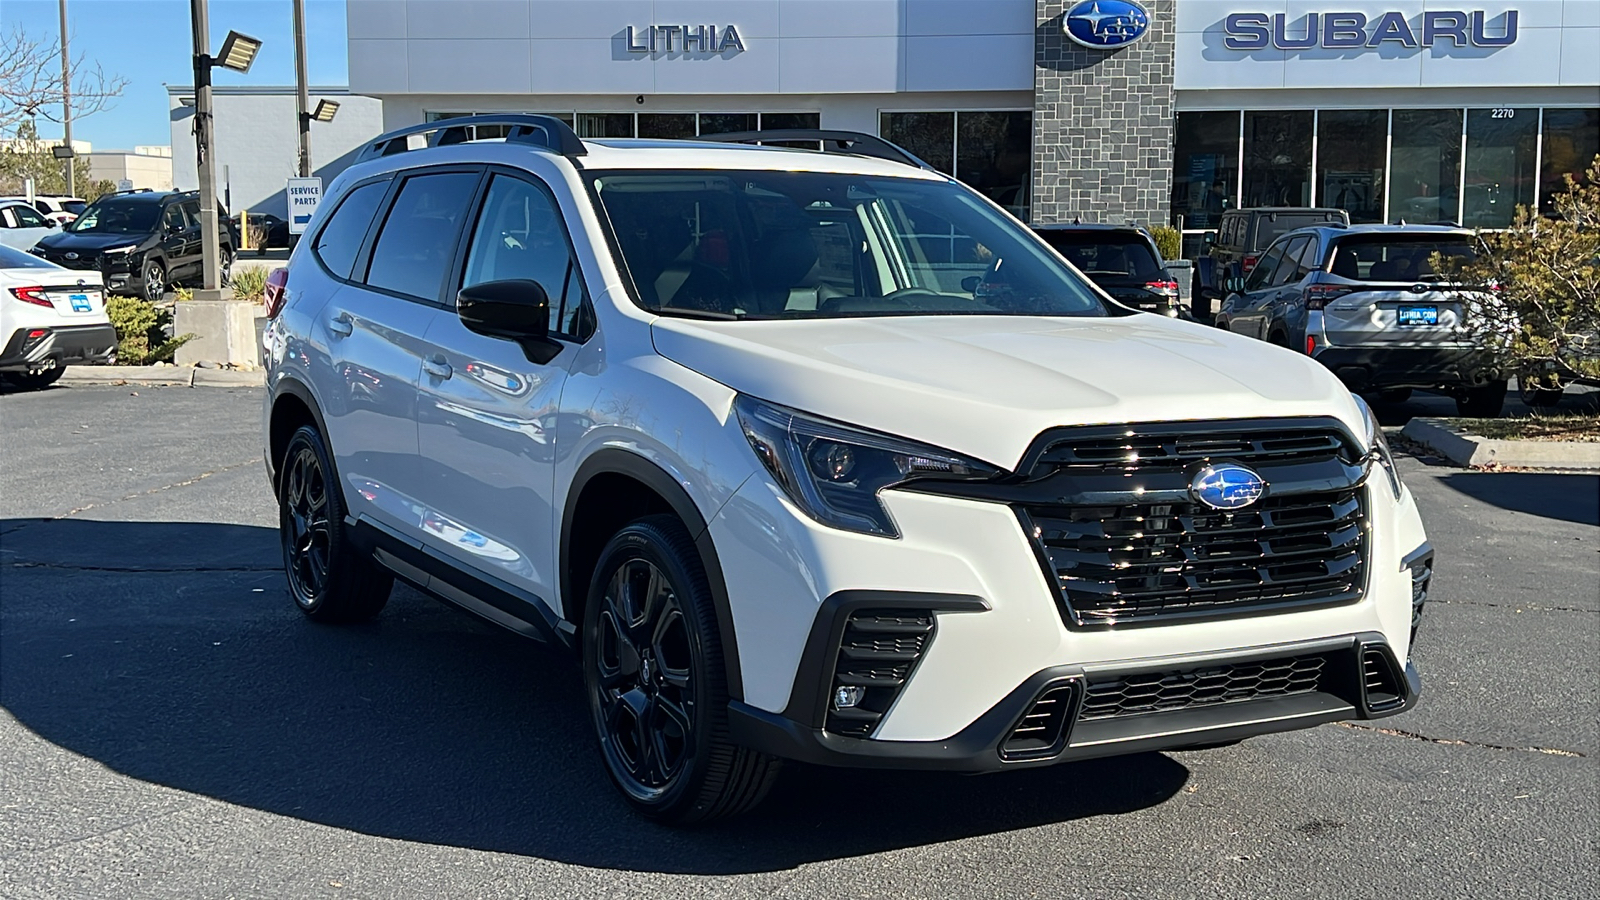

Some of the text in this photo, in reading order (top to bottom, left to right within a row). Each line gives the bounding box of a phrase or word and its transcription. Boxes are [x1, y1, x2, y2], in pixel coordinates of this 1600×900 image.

[1224, 10, 1518, 49] SUBARU
[626, 25, 746, 52] LITHIA
[1491, 108, 1515, 119] 2270
[290, 187, 319, 195] SERVICE
[294, 197, 317, 205] PARTS
